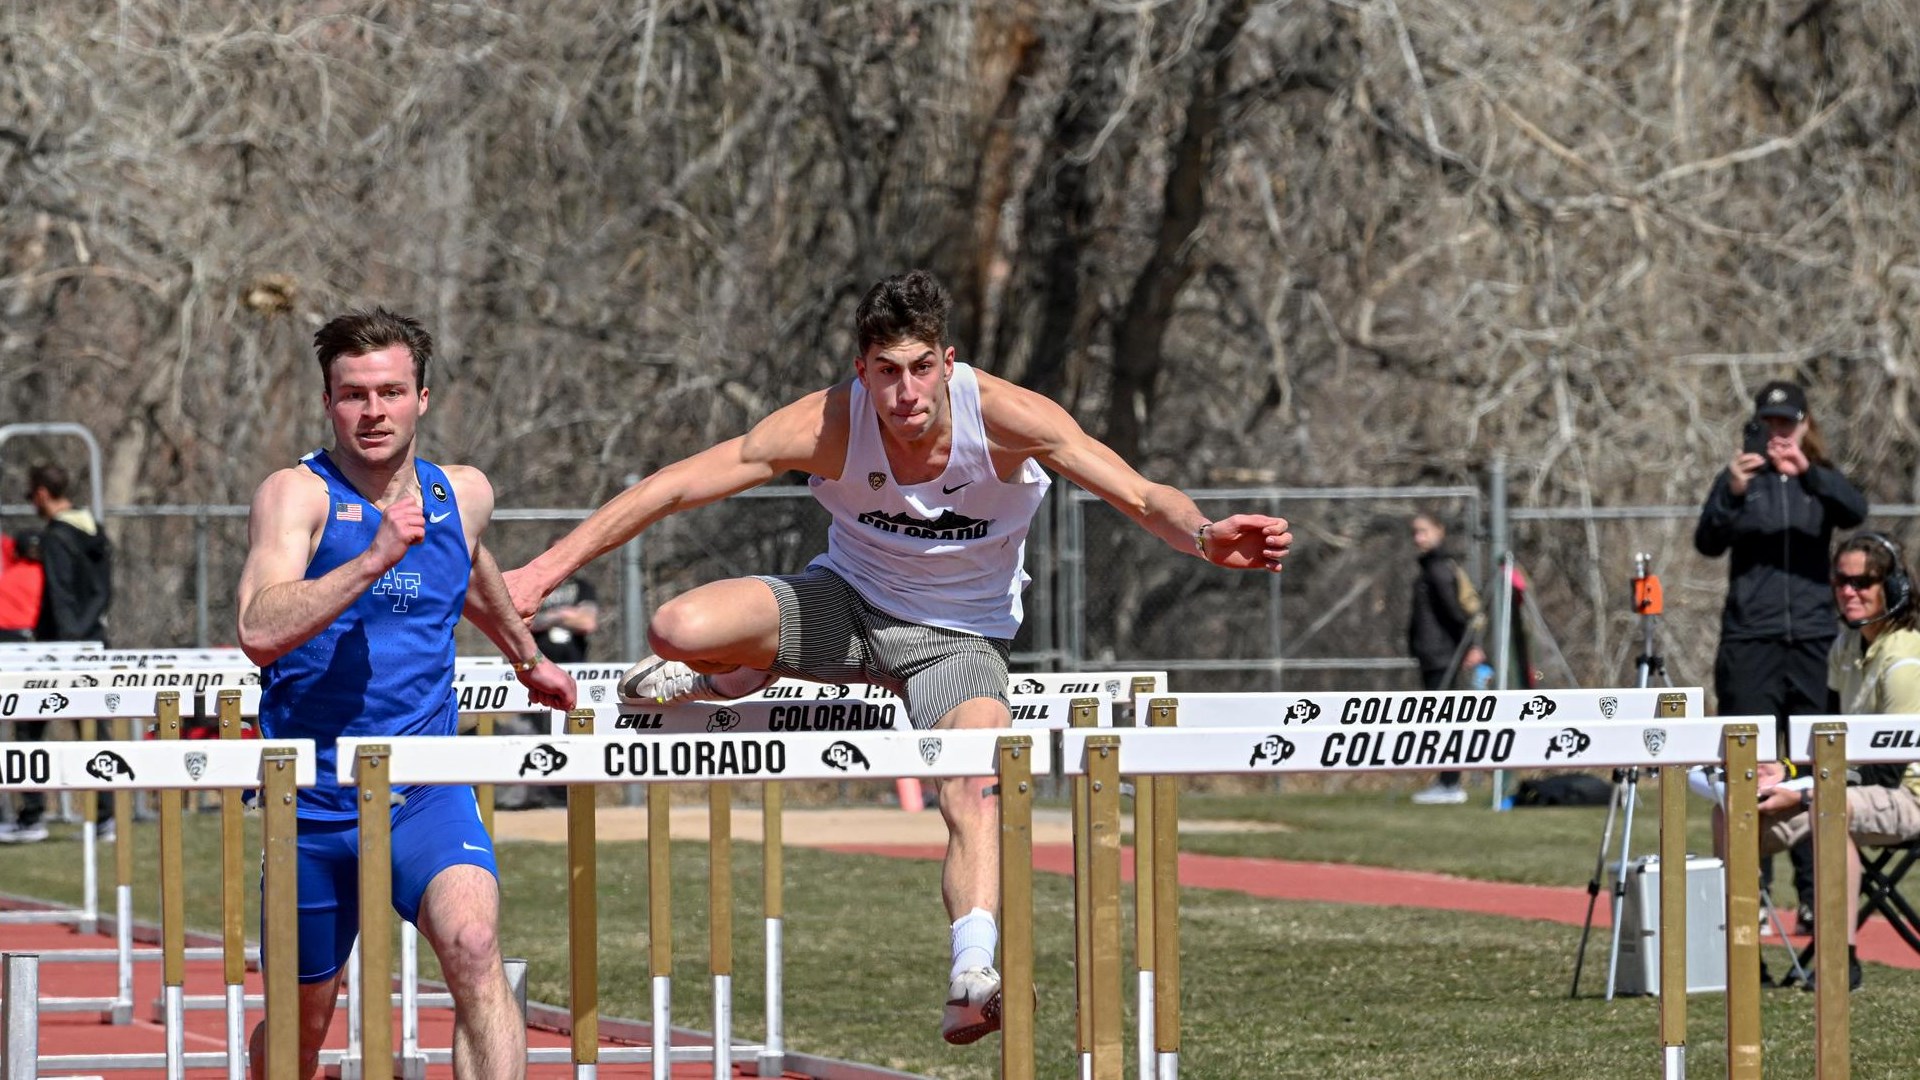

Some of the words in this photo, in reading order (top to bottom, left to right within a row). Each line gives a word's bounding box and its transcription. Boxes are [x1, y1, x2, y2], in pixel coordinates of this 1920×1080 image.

[453, 685, 509, 710] ADO
[763, 686, 804, 698] GILL
[1060, 683, 1100, 694] GILL
[615, 713, 664, 729] GILL
[768, 703, 896, 732] COLORADO
[1340, 695, 1498, 725] COLORADO
[604, 739, 786, 776] COLORADO
[1320, 728, 1516, 767] COLORADO
[0, 748, 50, 784] DO
